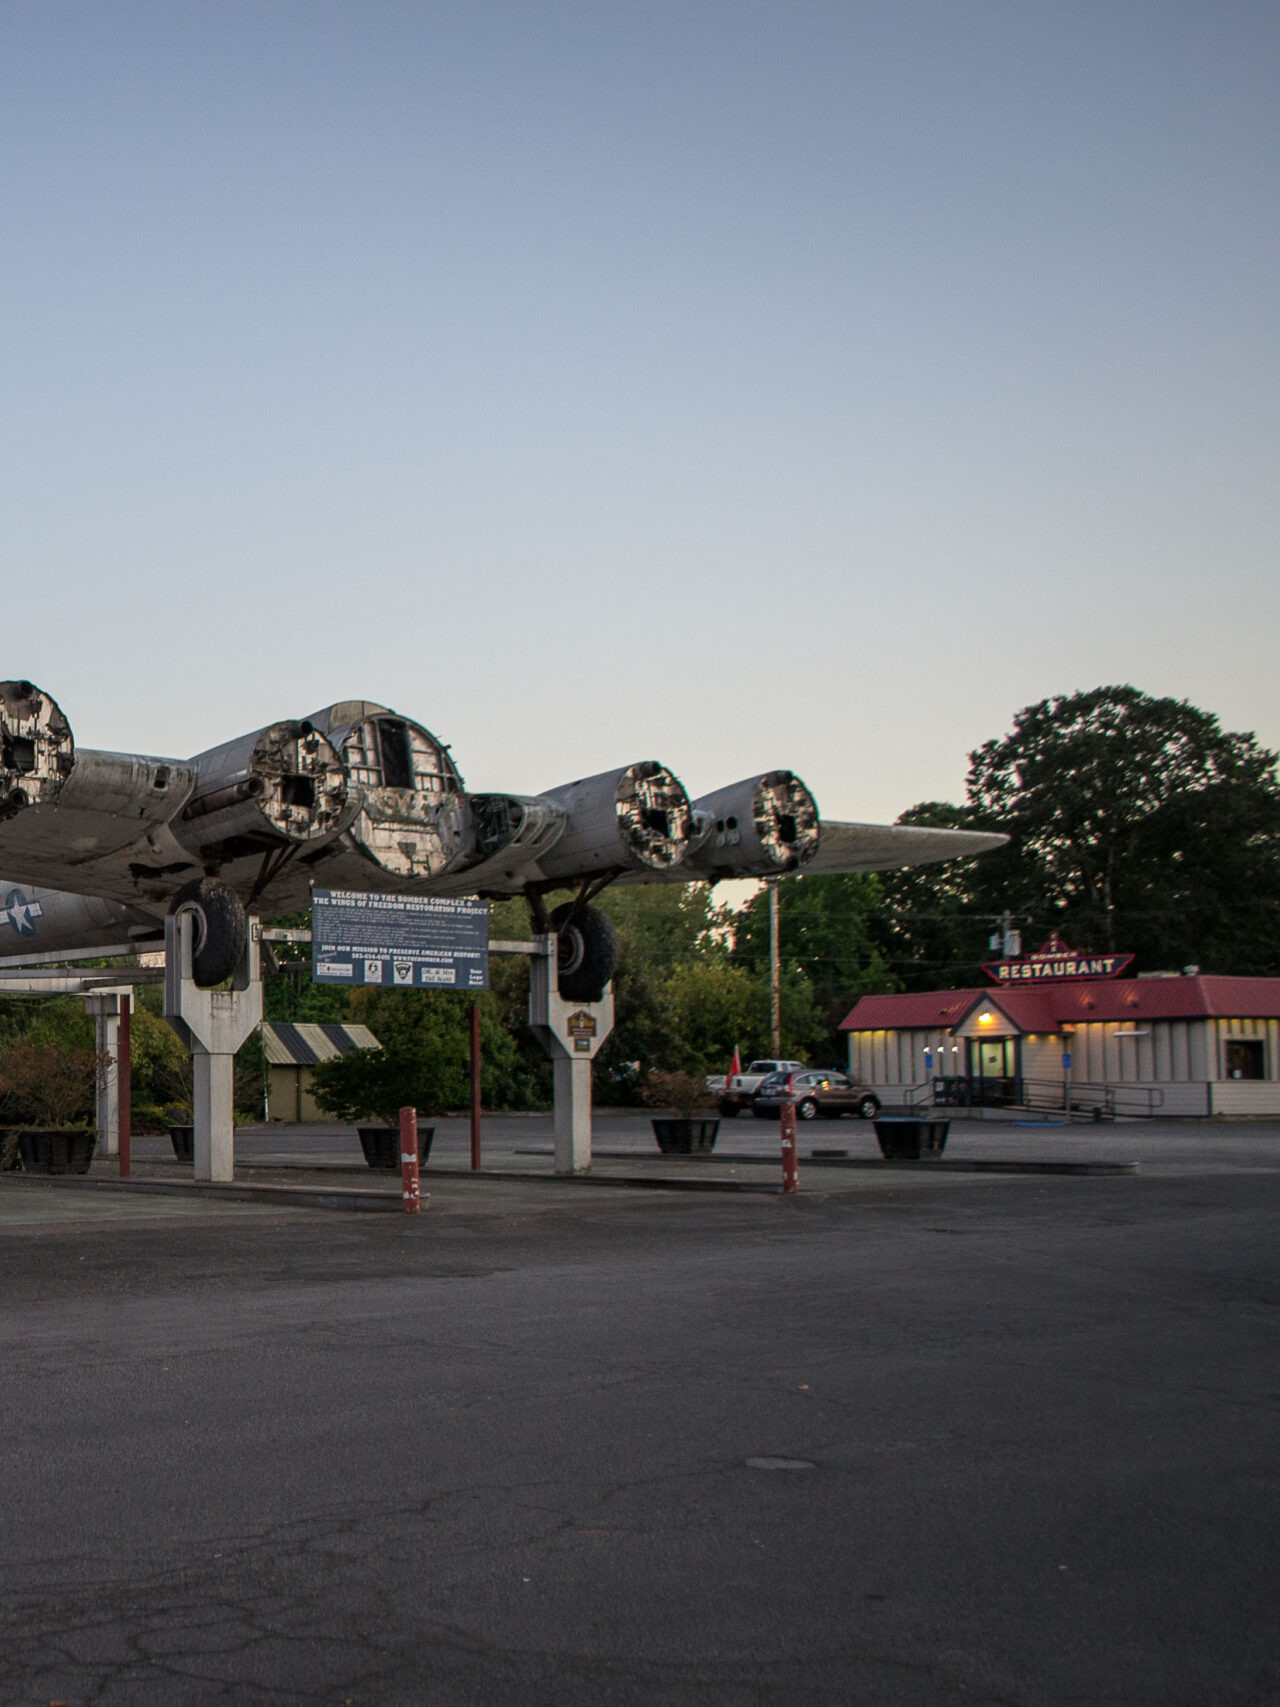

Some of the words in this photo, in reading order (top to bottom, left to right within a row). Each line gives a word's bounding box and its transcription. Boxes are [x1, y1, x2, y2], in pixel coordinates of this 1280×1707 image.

[313, 897, 329, 905] THE
[330, 898, 356, 907] WINGS
[368, 901, 405, 909] FREEDOM
[405, 903, 456, 913] RESTORATION
[456, 907, 488, 915] PROJECT
[330, 890, 368, 900] WELCOME
[369, 893, 380, 901] TO
[380, 894, 396, 902] THE
[397, 895, 429, 904] BOMBER
[430, 897, 465, 906] COMPLEX
[388, 948, 420, 956] PRESERVE
[421, 949, 453, 957] AMERICAN
[998, 958, 1115, 979] RESTAURANT
